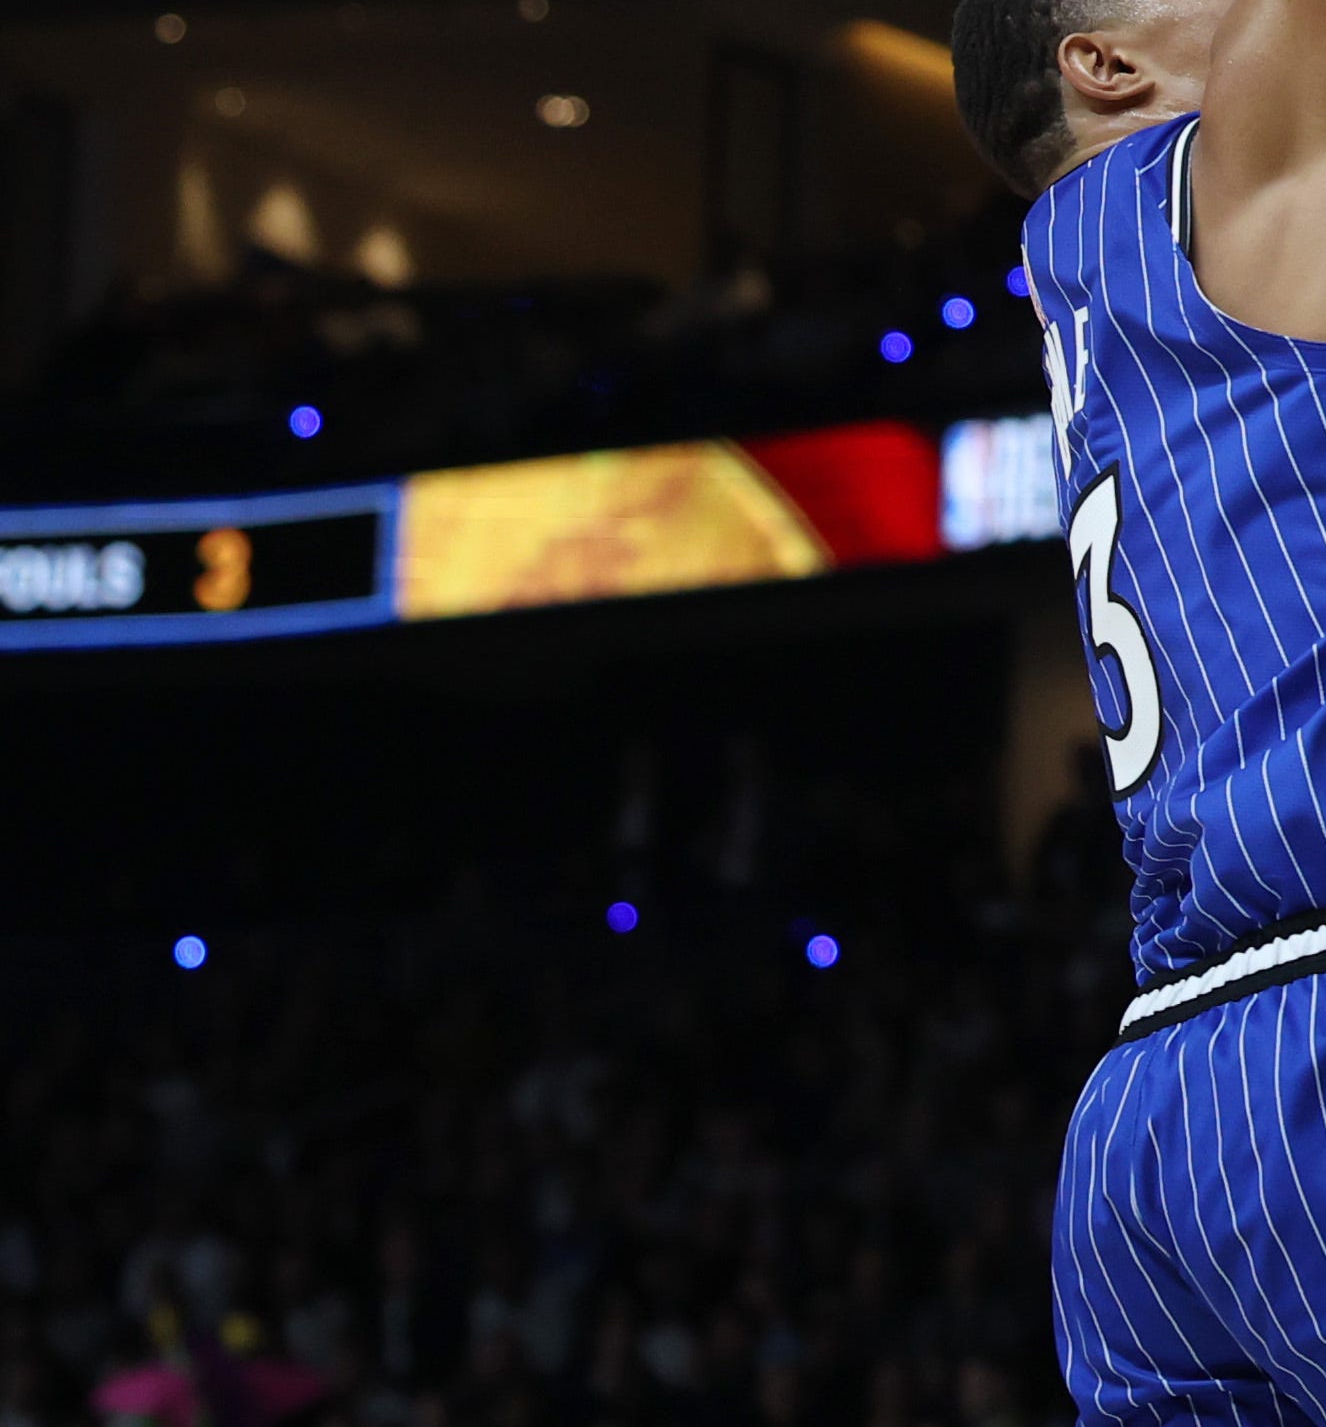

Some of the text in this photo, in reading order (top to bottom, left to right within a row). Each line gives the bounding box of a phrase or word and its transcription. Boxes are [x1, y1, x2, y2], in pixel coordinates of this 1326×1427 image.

[0, 527, 253, 613] OULS 3
[1068, 460, 1164, 802] 3
